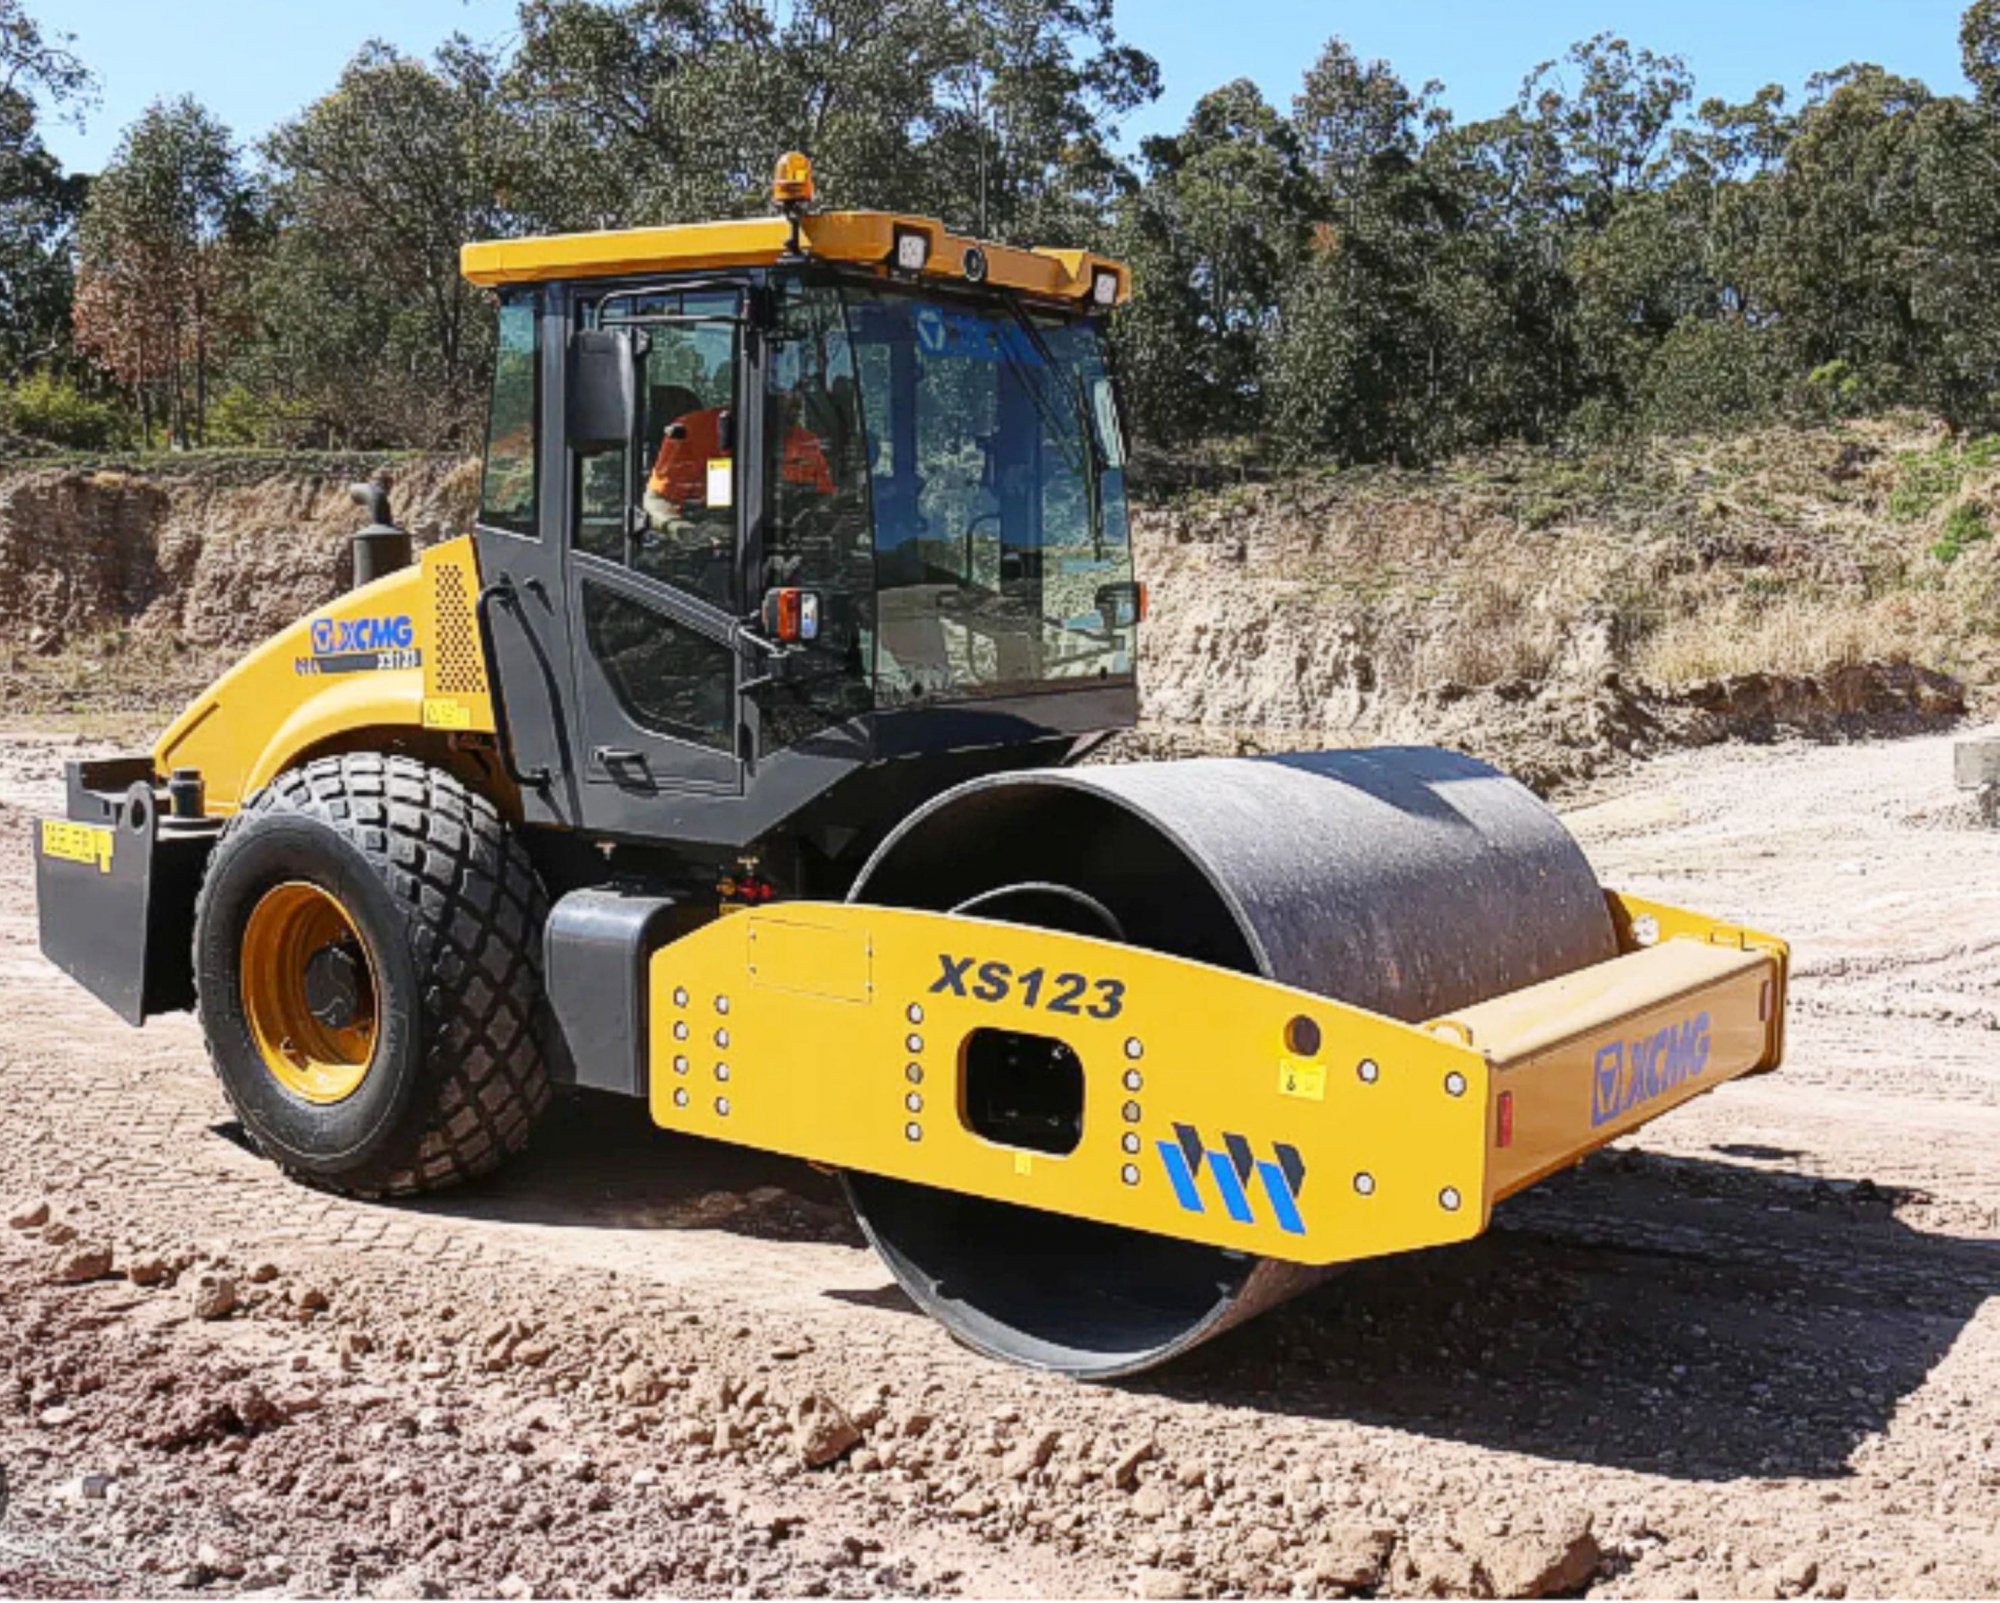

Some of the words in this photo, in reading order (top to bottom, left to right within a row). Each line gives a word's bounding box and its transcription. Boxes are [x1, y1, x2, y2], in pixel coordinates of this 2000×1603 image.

[338, 615, 413, 651] XCMG
[928, 954, 1126, 1019] XS123
[1623, 1011, 1711, 1110] XCMG
